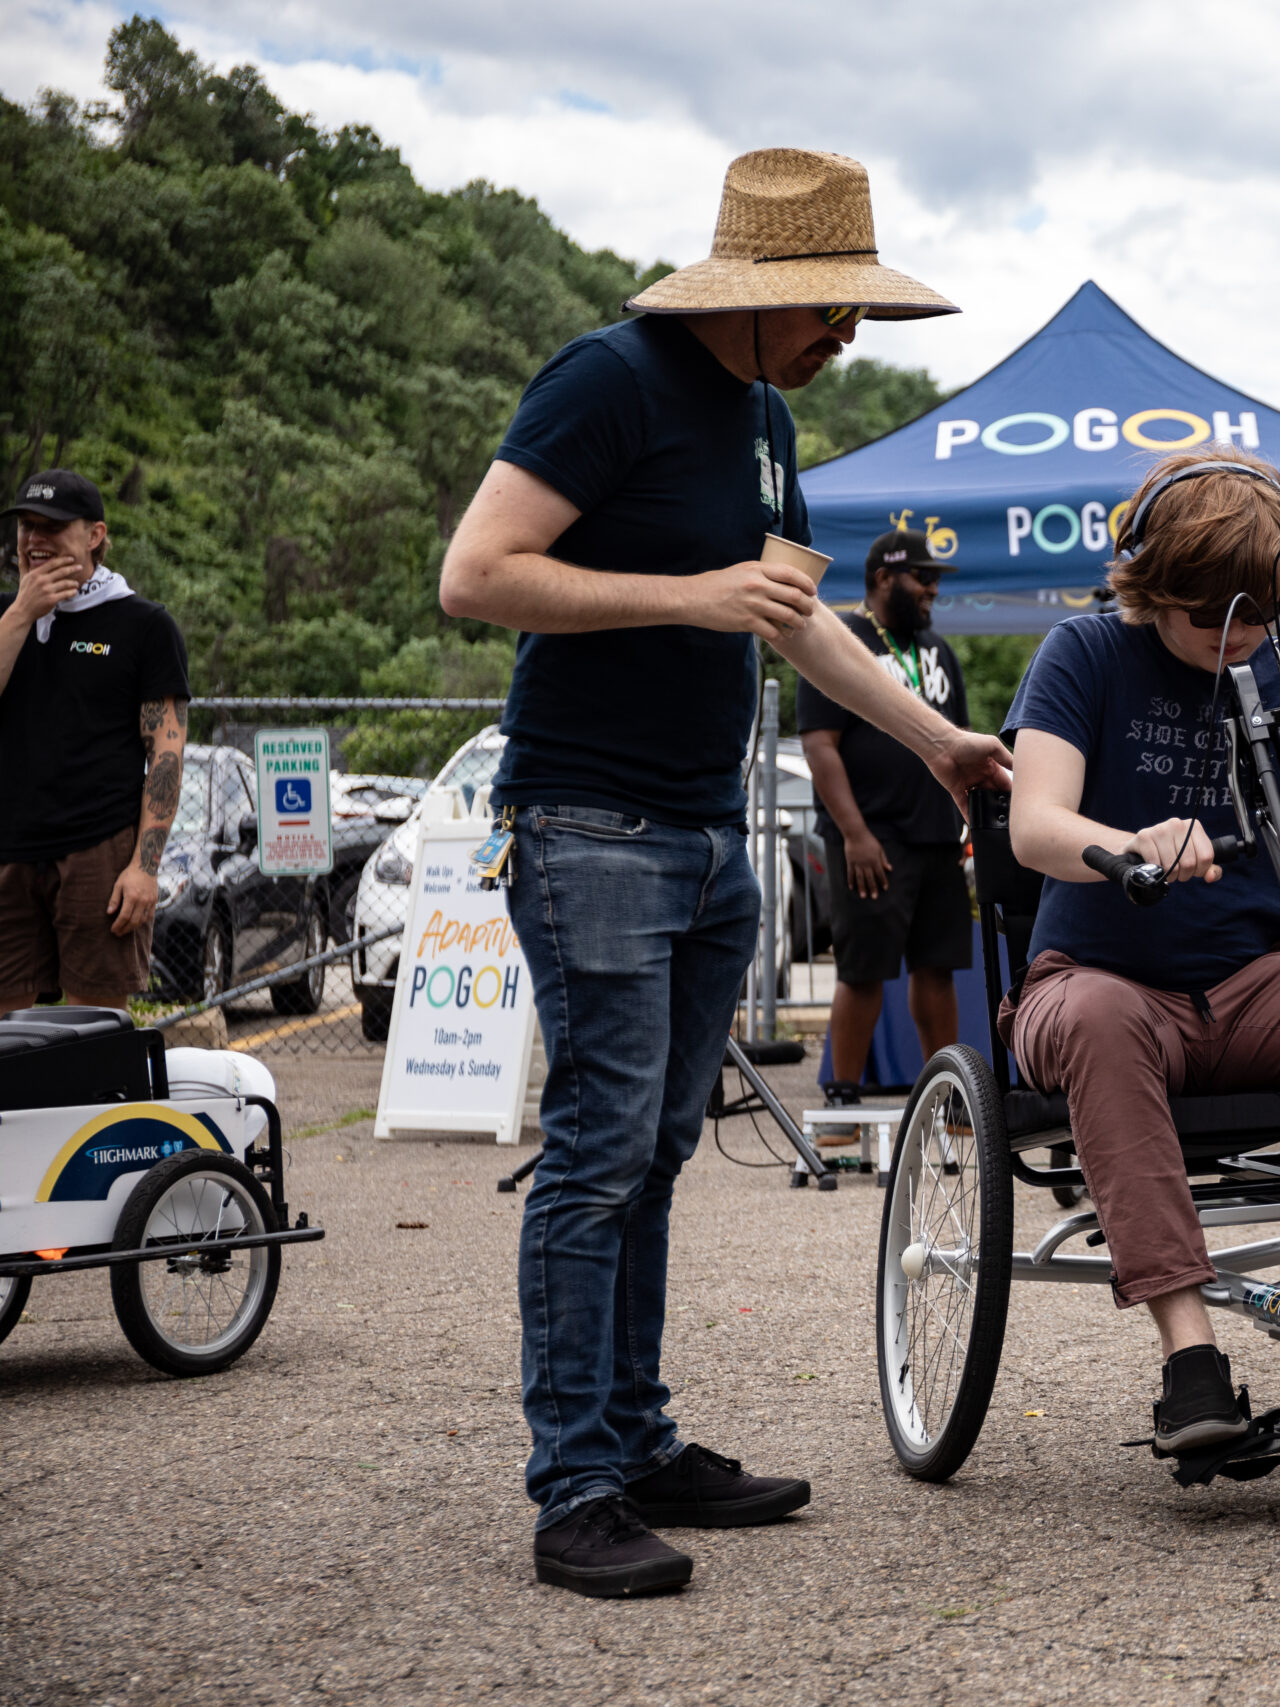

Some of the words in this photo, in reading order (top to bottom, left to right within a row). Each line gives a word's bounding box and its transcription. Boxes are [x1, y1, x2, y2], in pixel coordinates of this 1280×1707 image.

[935, 408, 1260, 460] POGOH
[1007, 501, 1131, 556] POG
[69, 640, 112, 656] POGOH
[1148, 697, 1182, 719] SO
[1125, 719, 1188, 749] SIDE
[262, 741, 322, 755] RESERVED
[266, 759, 320, 773] PARKING
[1136, 752, 1174, 775] SO
[426, 864, 440, 877] Walk
[423, 882, 451, 894] Welcome
[409, 964, 520, 1009] POGOH
[405, 1058, 456, 1078] Wednesday
[458, 1060, 465, 1076] &
[467, 1059, 502, 1079] Sunday
[93, 1145, 160, 1165] HIGHMARK
